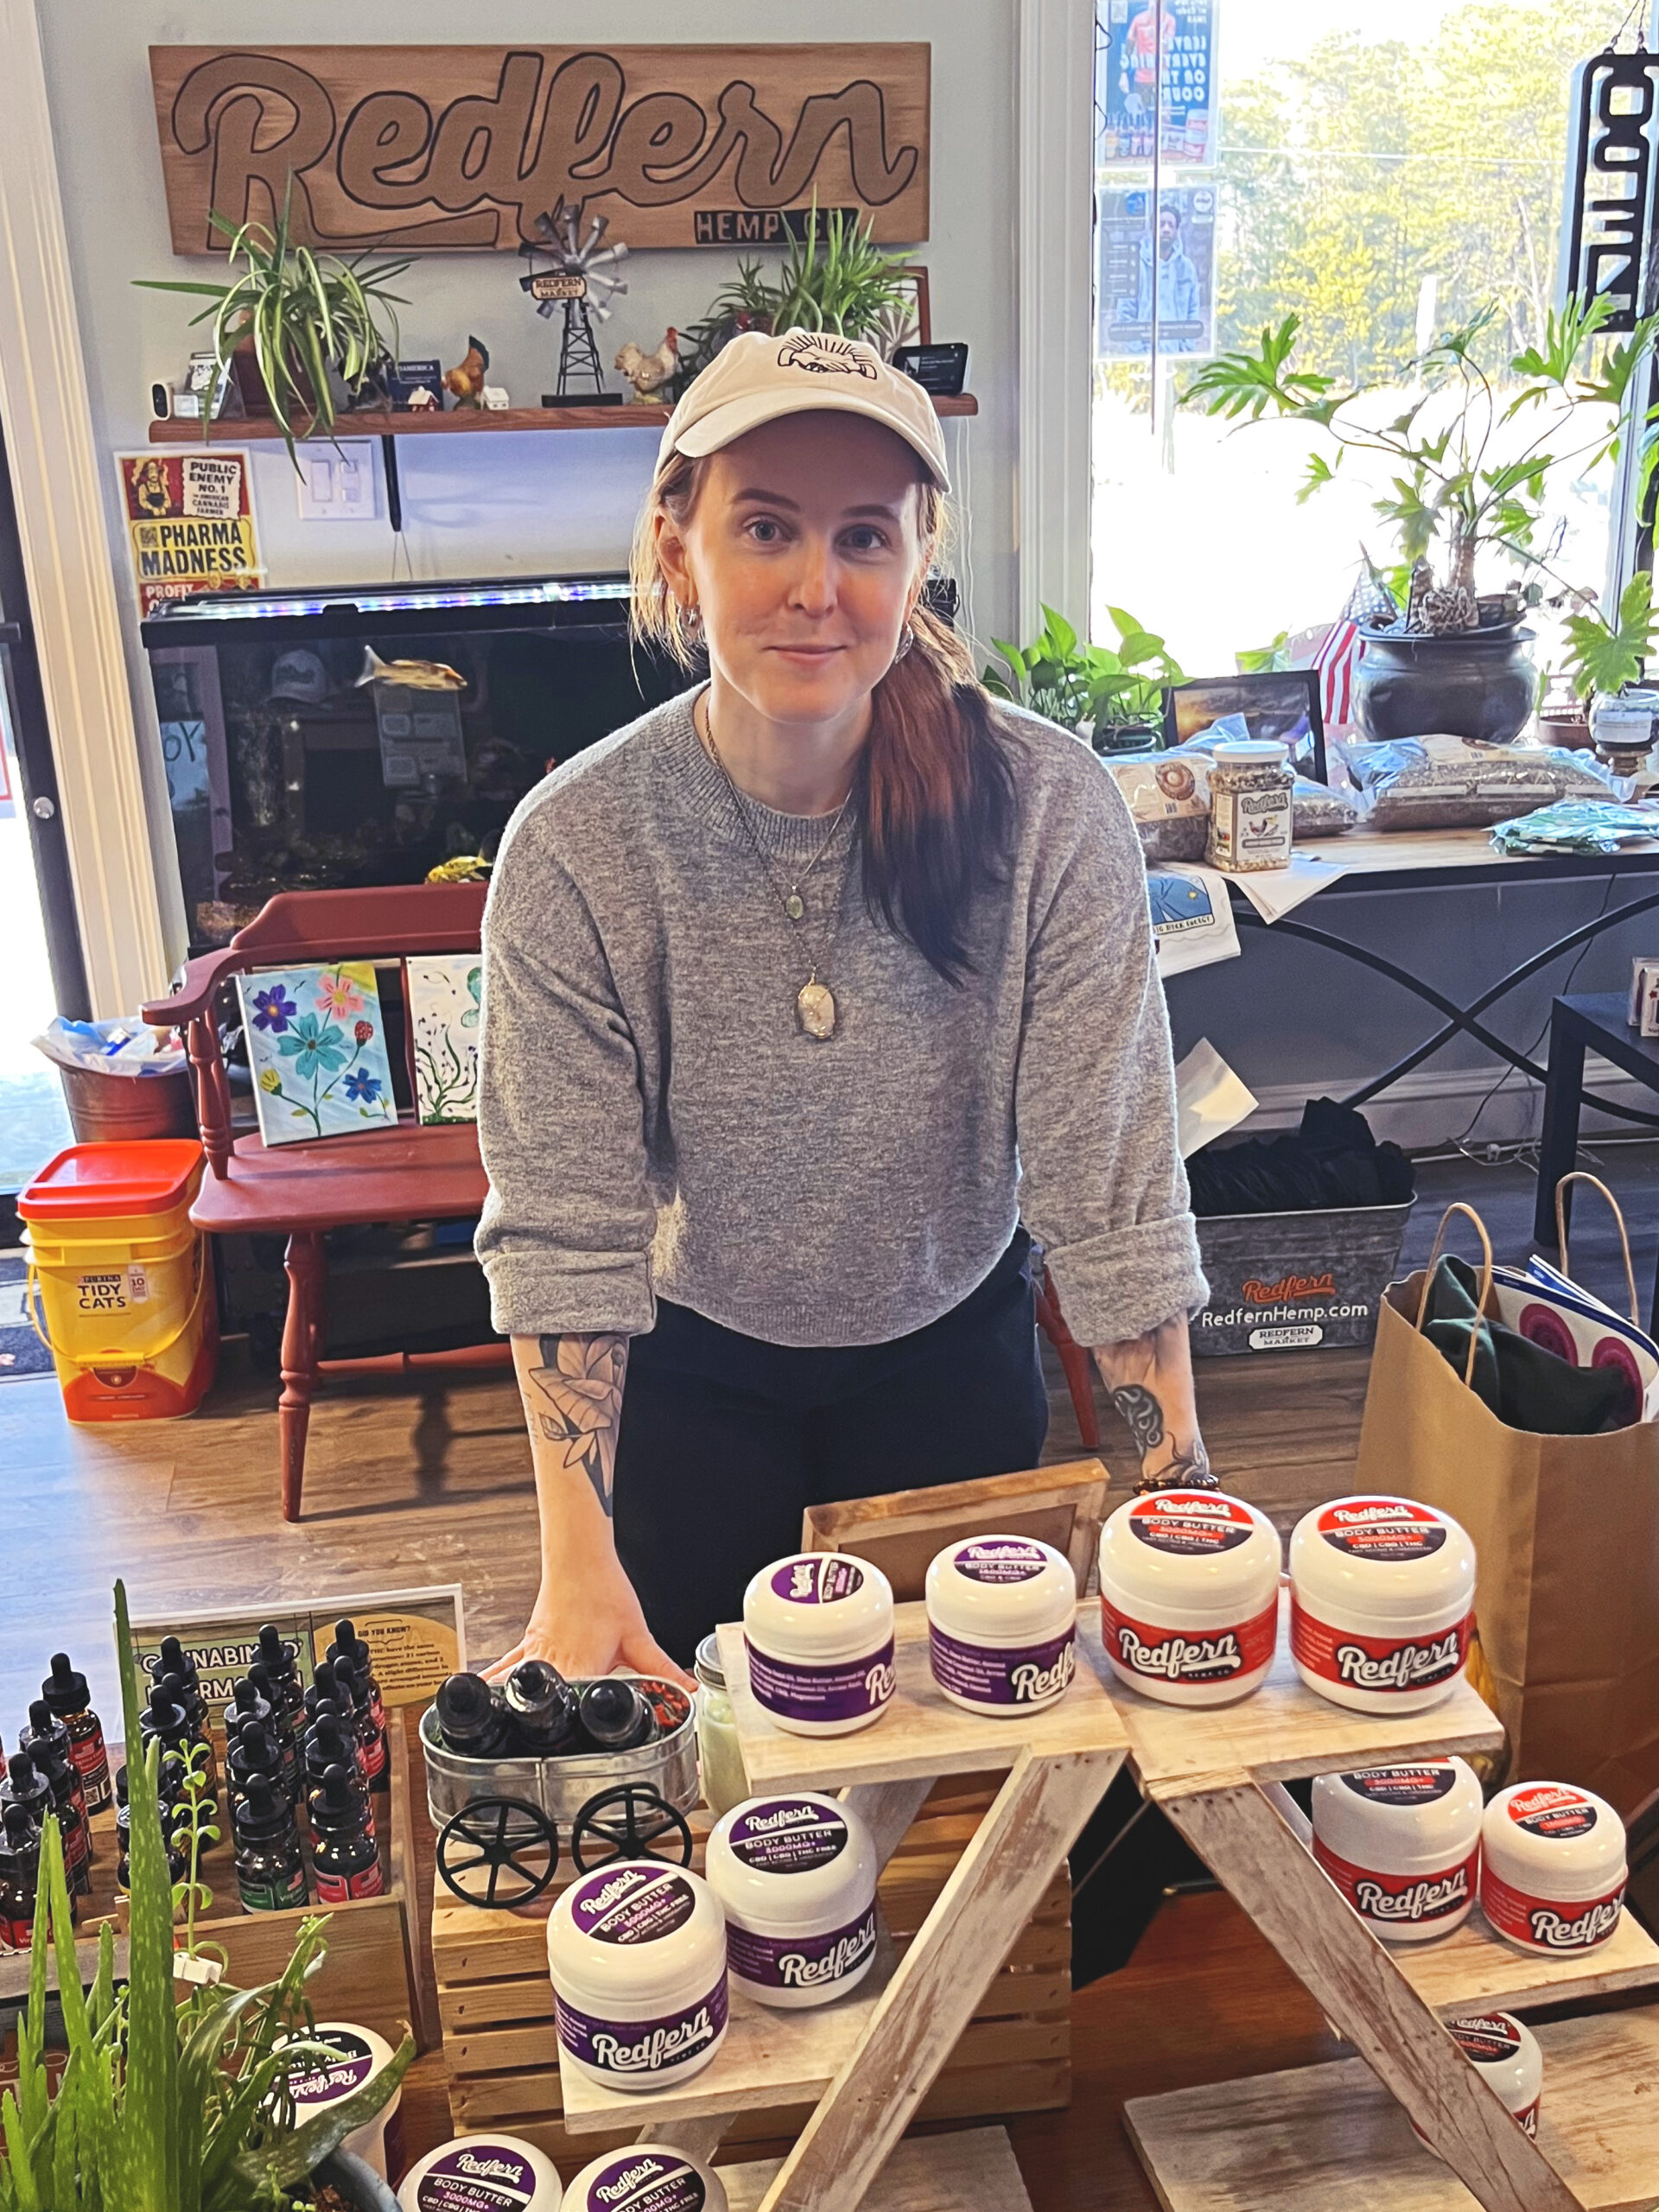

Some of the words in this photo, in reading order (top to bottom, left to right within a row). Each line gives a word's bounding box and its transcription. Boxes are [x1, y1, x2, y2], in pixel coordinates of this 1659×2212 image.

[173, 53, 918, 249] Redfern
[696, 210, 779, 243] HEMP
[536, 278, 582, 288] REDFERN
[540, 289, 578, 297] MARKET
[191, 461, 237, 474] PUBLIC
[189, 473, 234, 485] ENEMY
[199, 484, 218, 493] NO.
[220, 485, 226, 493] 1
[193, 499, 230, 509] CANNABIS
[197, 507, 224, 516] FARMER
[160, 521, 243, 548] PHARMA
[141, 546, 248, 576] MADNESS
[85, 1274, 120, 1283] PURINA
[131, 1277, 145, 1287] 10
[78, 1283, 122, 1297] TIDY
[1242, 1273, 1337, 1304] Redfern
[79, 1296, 127, 1310] CATS
[1202, 1303, 1369, 1328] RedfernHemp.com
[1259, 1327, 1314, 1338] REDFERN
[1263, 1336, 1311, 1345] MARKET
[1154, 1498, 1232, 1517] Redfern
[1333, 1505, 1414, 1523] Redfern
[1141, 1516, 1179, 1526] BODY
[1183, 1521, 1236, 1534] BUTTER
[1334, 1528, 1375, 1538] BODY
[1376, 1527, 1430, 1535] BUTTER
[968, 1545, 1041, 1559] Redfern
[997, 1563, 1040, 1572] BUTTER
[386, 1625, 410, 1634] KNOW?
[1118, 1628, 1242, 1679] Redfern
[1337, 1630, 1459, 1688] Redfern
[1353, 1770, 1388, 1780] BODY
[1391, 1768, 1440, 1777] BUTTER
[1510, 1789, 1577, 1812] Redfern
[745, 1805, 819, 1831] Redfern
[1524, 1814, 1551, 1825] BODY
[1552, 1807, 1590, 1819] BUTTER
[745, 1837, 779, 1850] BODY
[784, 1829, 832, 1843] BUTTER
[580, 1870, 647, 1915] Redfern
[1357, 1867, 1469, 1919] Redfern
[600, 1908, 632, 1933] BODY
[631, 1883, 674, 1911] BUTTER
[779, 1912, 876, 1986] Redfern
[592, 2006, 714, 2071] Redfern
[456, 2153, 524, 2184] Redfern
[595, 2158, 664, 2203] Redfern
[434, 2177, 467, 2192] BODY
[467, 2187, 513, 2208] BUTTER
[443, 2191, 490, 2209] 3000MG+
[643, 2177, 687, 2205] BUTTER
[423, 2196, 439, 2205] CBD
[442, 2201, 461, 2211] CBG
